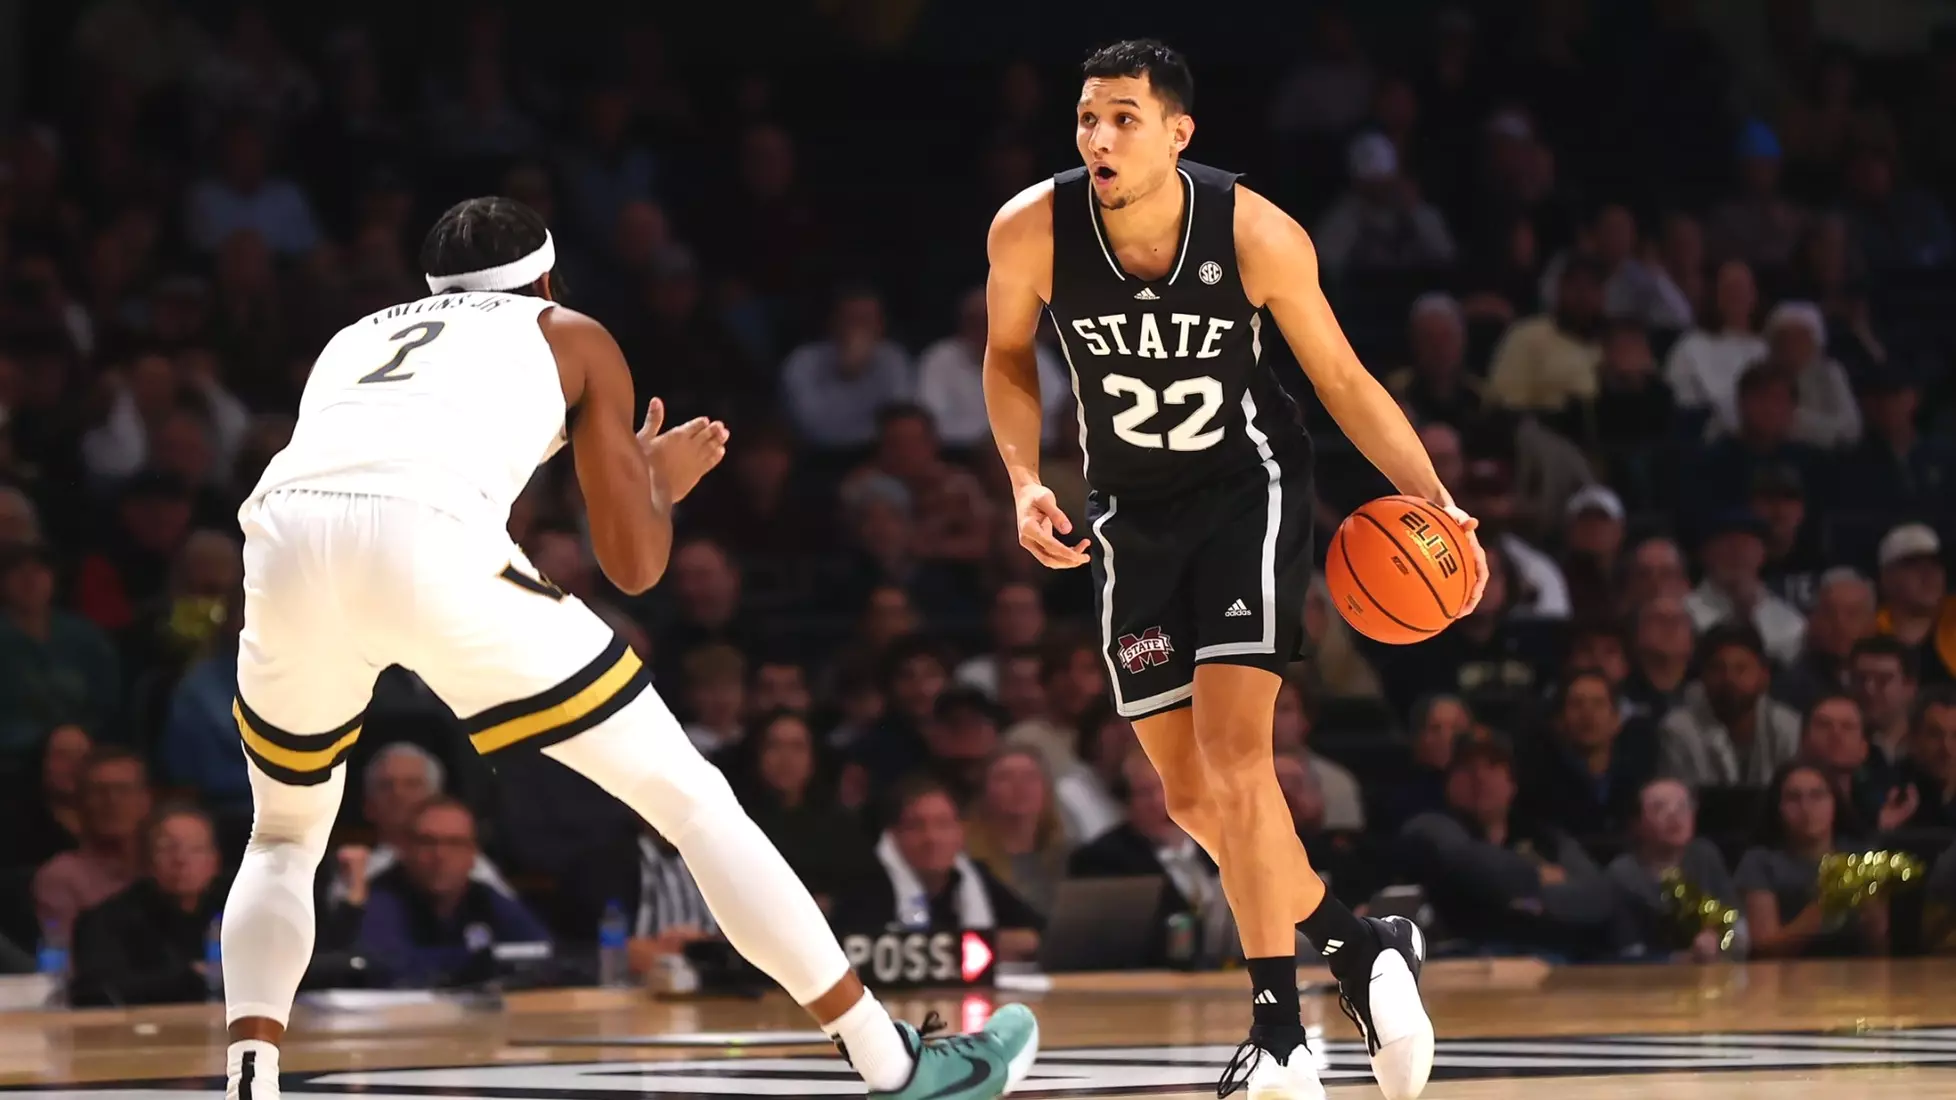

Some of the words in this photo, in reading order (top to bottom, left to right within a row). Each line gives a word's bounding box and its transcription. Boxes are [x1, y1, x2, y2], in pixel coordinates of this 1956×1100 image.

[1201, 264, 1220, 282] SEC
[358, 321, 445, 384] 2
[1072, 313, 1235, 359] STATE
[1101, 373, 1225, 452] 22
[1399, 512, 1458, 579] ELITE
[1225, 609, 1252, 617] adidas
[1126, 640, 1162, 660] STATE
